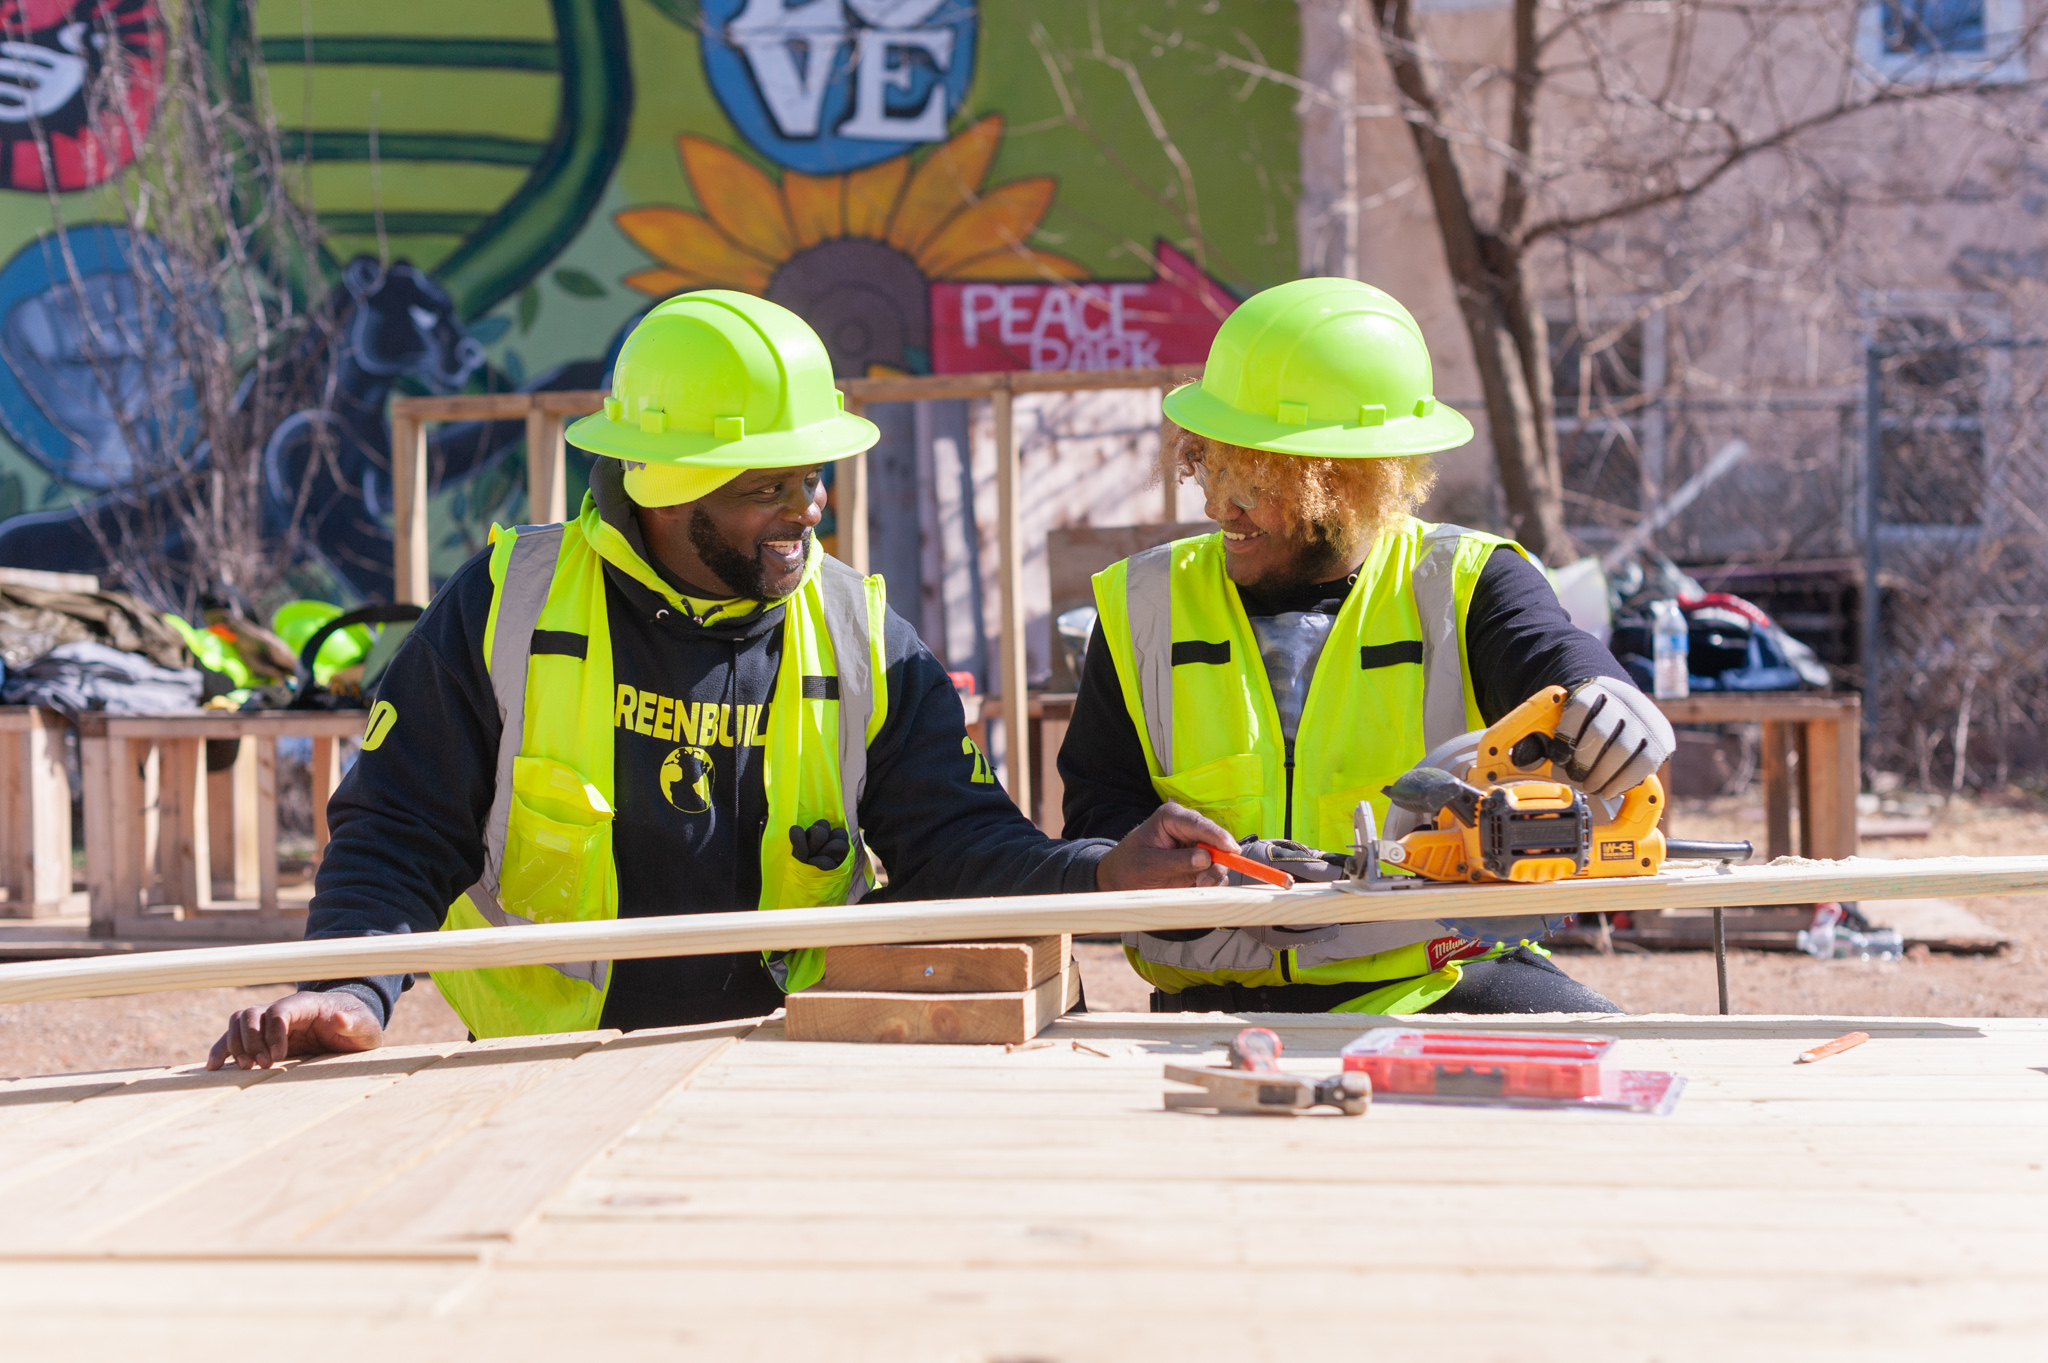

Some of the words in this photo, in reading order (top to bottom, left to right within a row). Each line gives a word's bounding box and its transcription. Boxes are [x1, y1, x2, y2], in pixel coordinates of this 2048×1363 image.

[730, 29, 952, 141] VE
[961, 283, 1149, 348] PEACE
[361, 698, 398, 752] 0
[614, 683, 772, 748] REENBUIL
